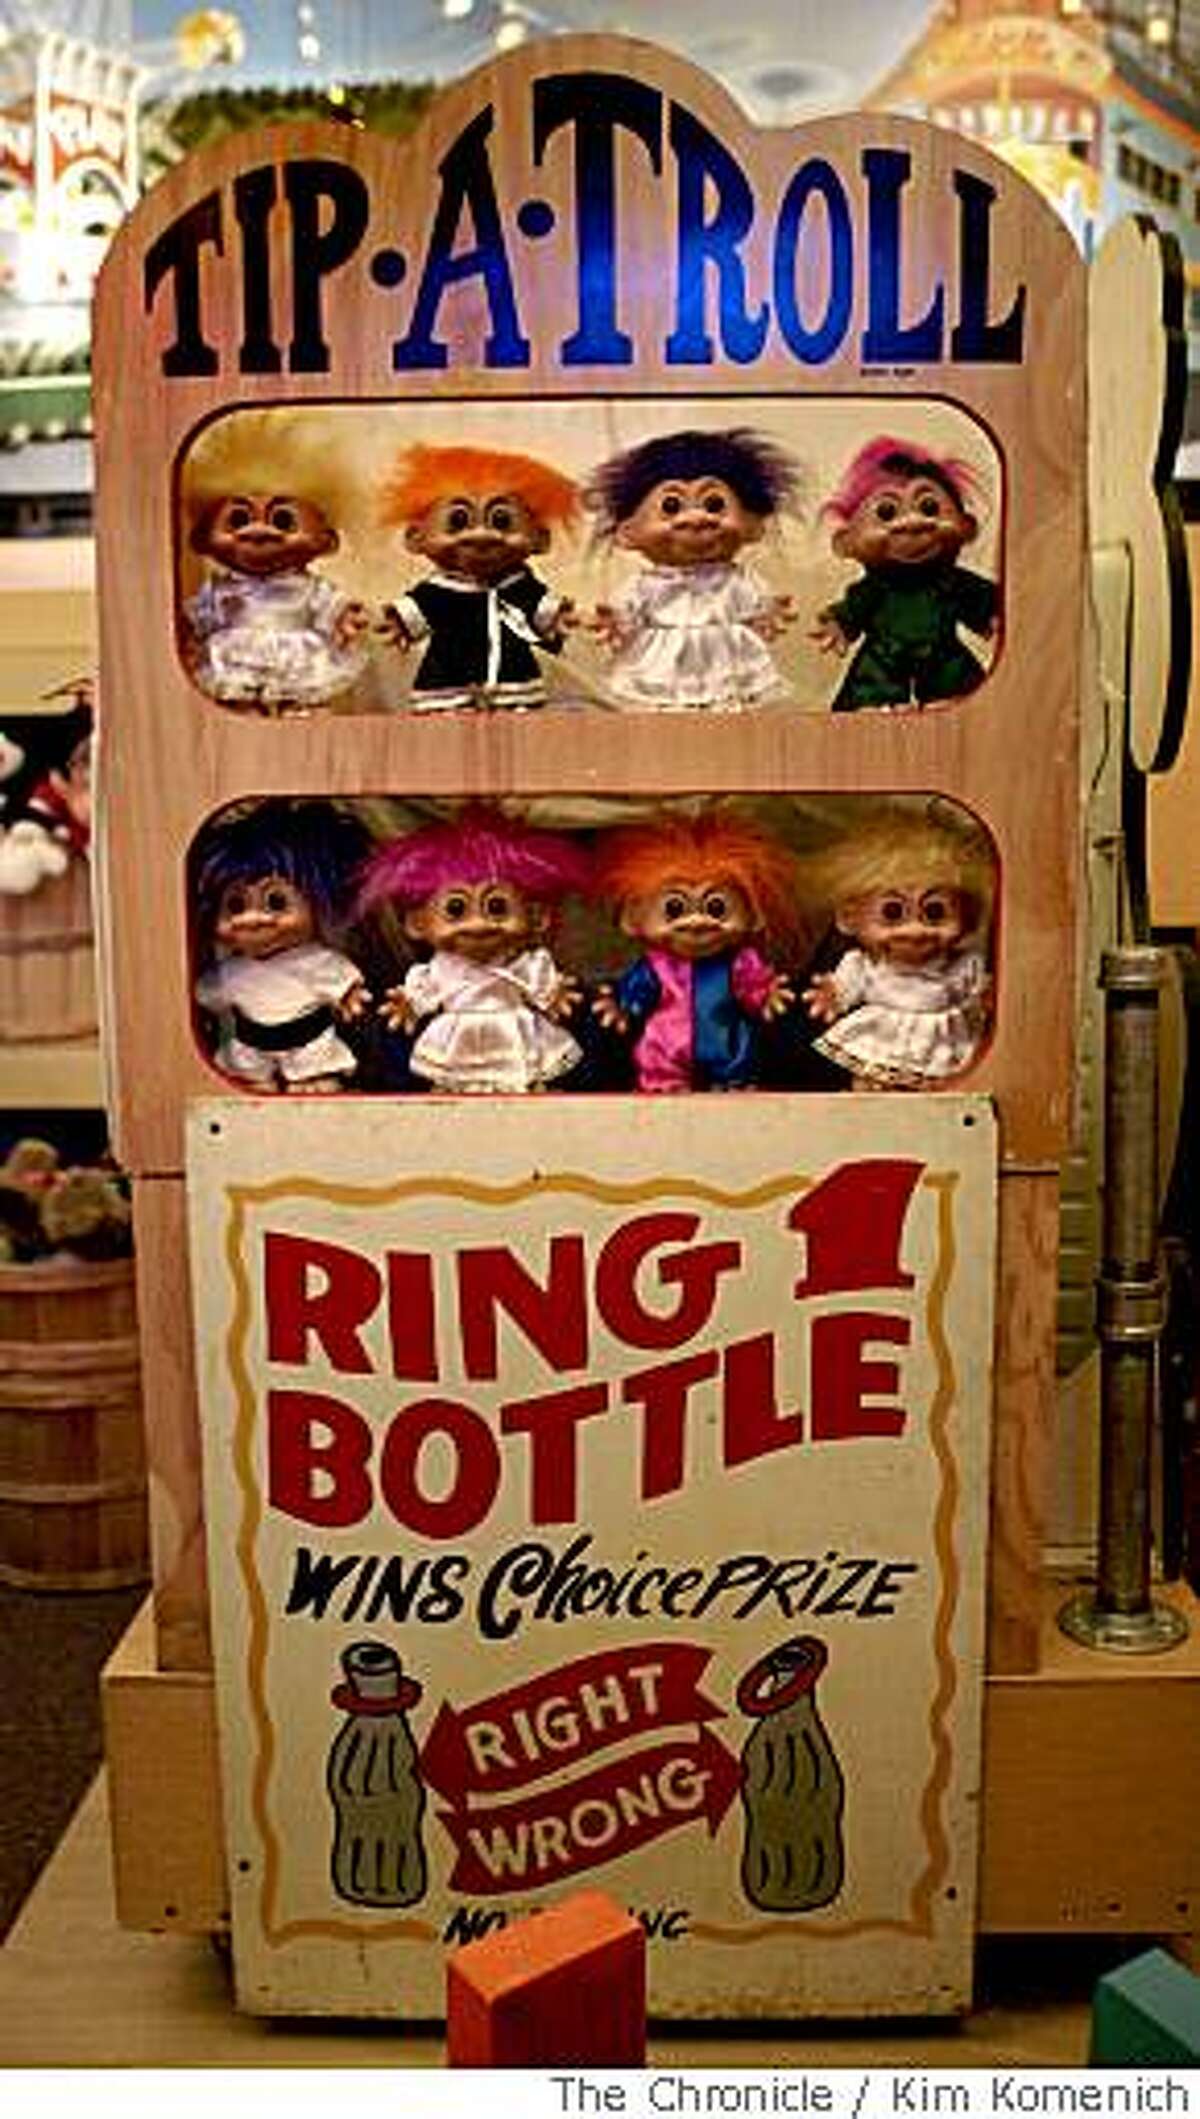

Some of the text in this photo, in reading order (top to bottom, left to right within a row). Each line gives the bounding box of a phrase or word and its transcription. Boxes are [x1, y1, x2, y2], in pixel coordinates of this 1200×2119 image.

[264, 1158, 927, 1383] RING 1
[266, 1311, 911, 1539] BOTTLE
[285, 1547, 470, 1622] WINS
[477, 1534, 703, 1640] Choice
[466, 1663, 663, 1775] RIGHT
[468, 1757, 712, 1880] WRONG
